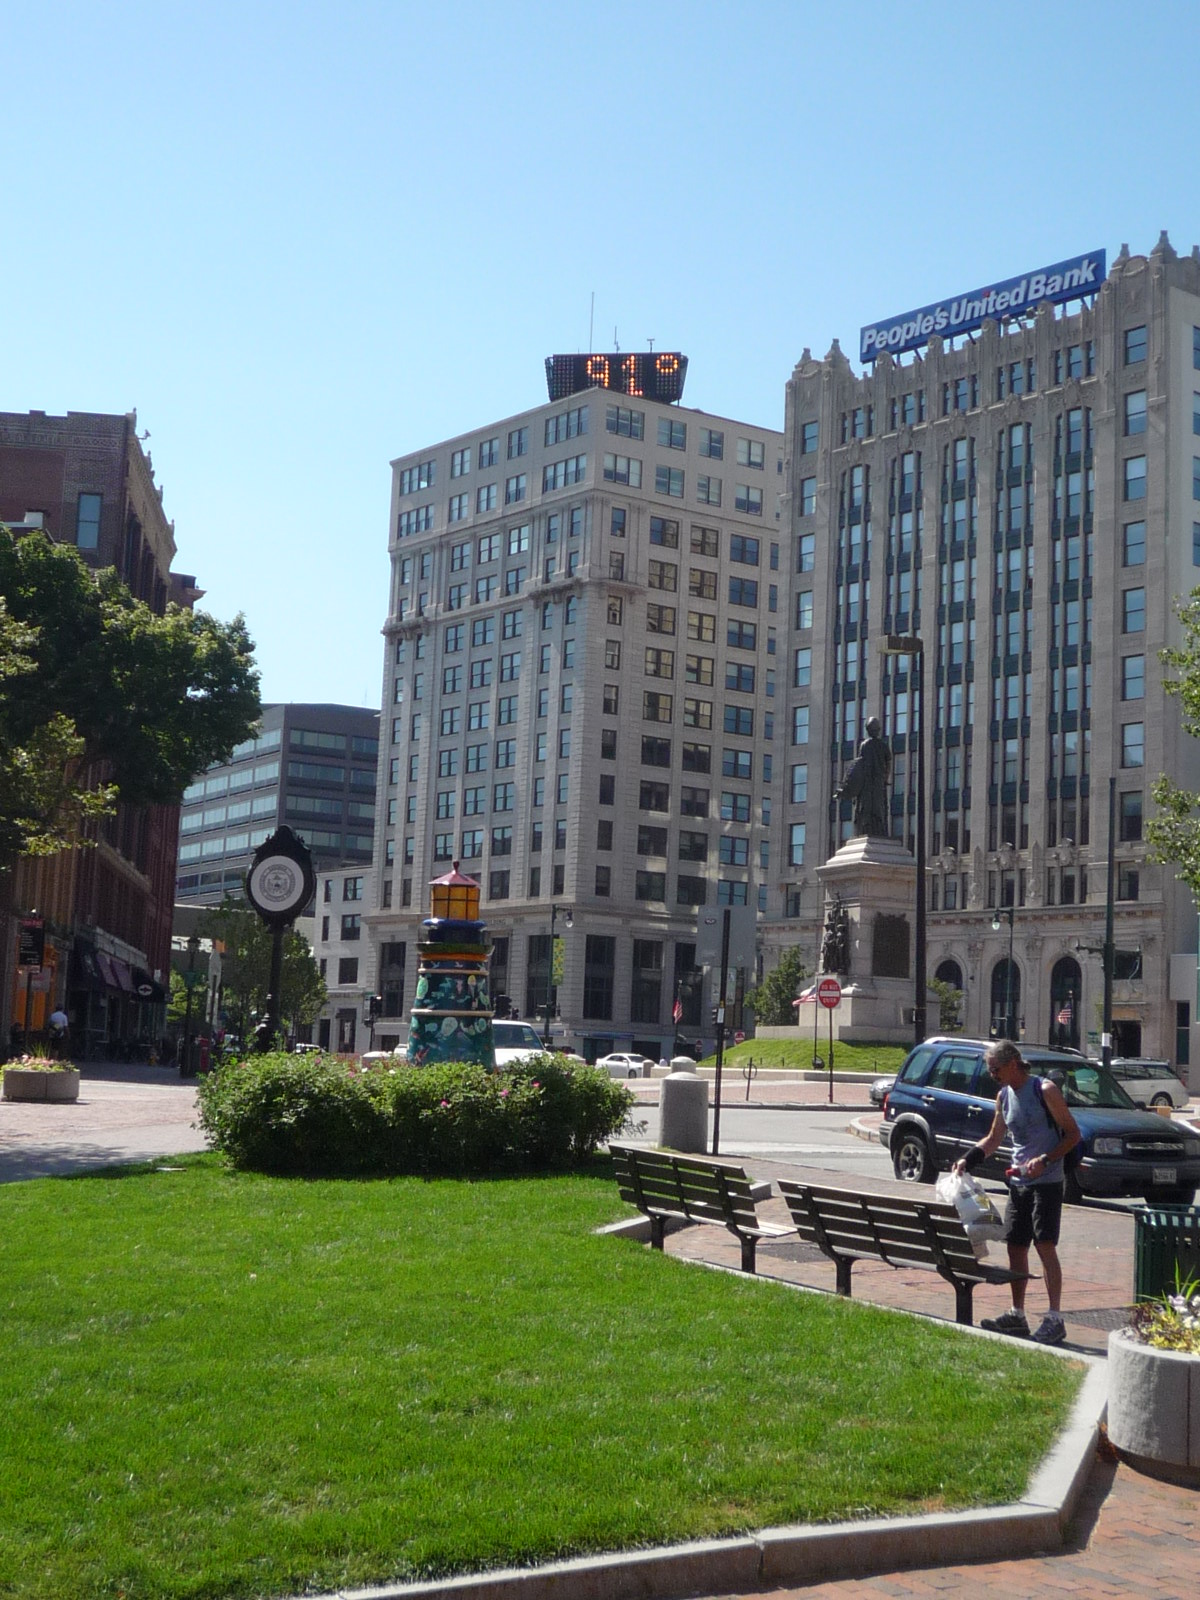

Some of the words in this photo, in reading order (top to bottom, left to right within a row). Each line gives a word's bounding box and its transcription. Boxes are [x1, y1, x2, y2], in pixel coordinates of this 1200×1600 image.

[862, 307, 949, 353] People's
[950, 279, 1028, 325] United
[1028, 259, 1096, 301] Bank
